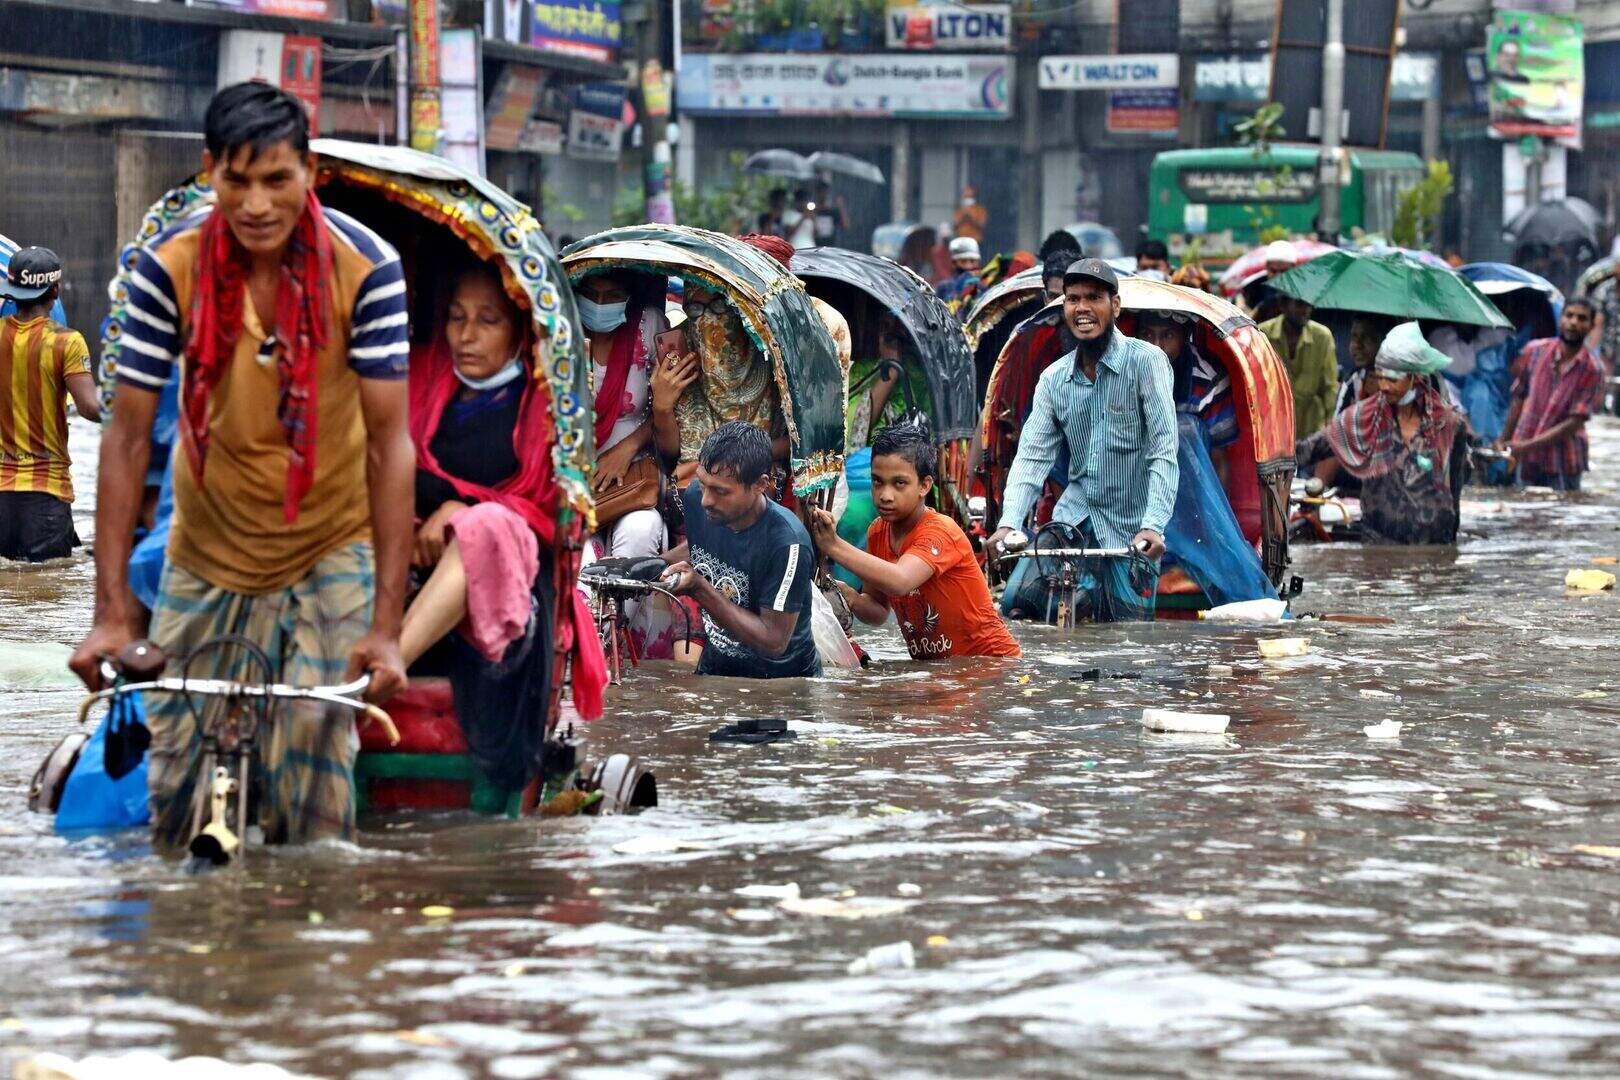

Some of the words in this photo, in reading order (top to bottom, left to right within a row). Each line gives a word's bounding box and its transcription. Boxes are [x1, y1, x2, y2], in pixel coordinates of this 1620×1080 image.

[892, 12, 1004, 38] WLTON
[853, 64, 932, 80] Dutch-Bangla
[935, 65, 963, 78] Bank
[1085, 64, 1158, 80] WALTON
[920, 634, 953, 654] Rock
